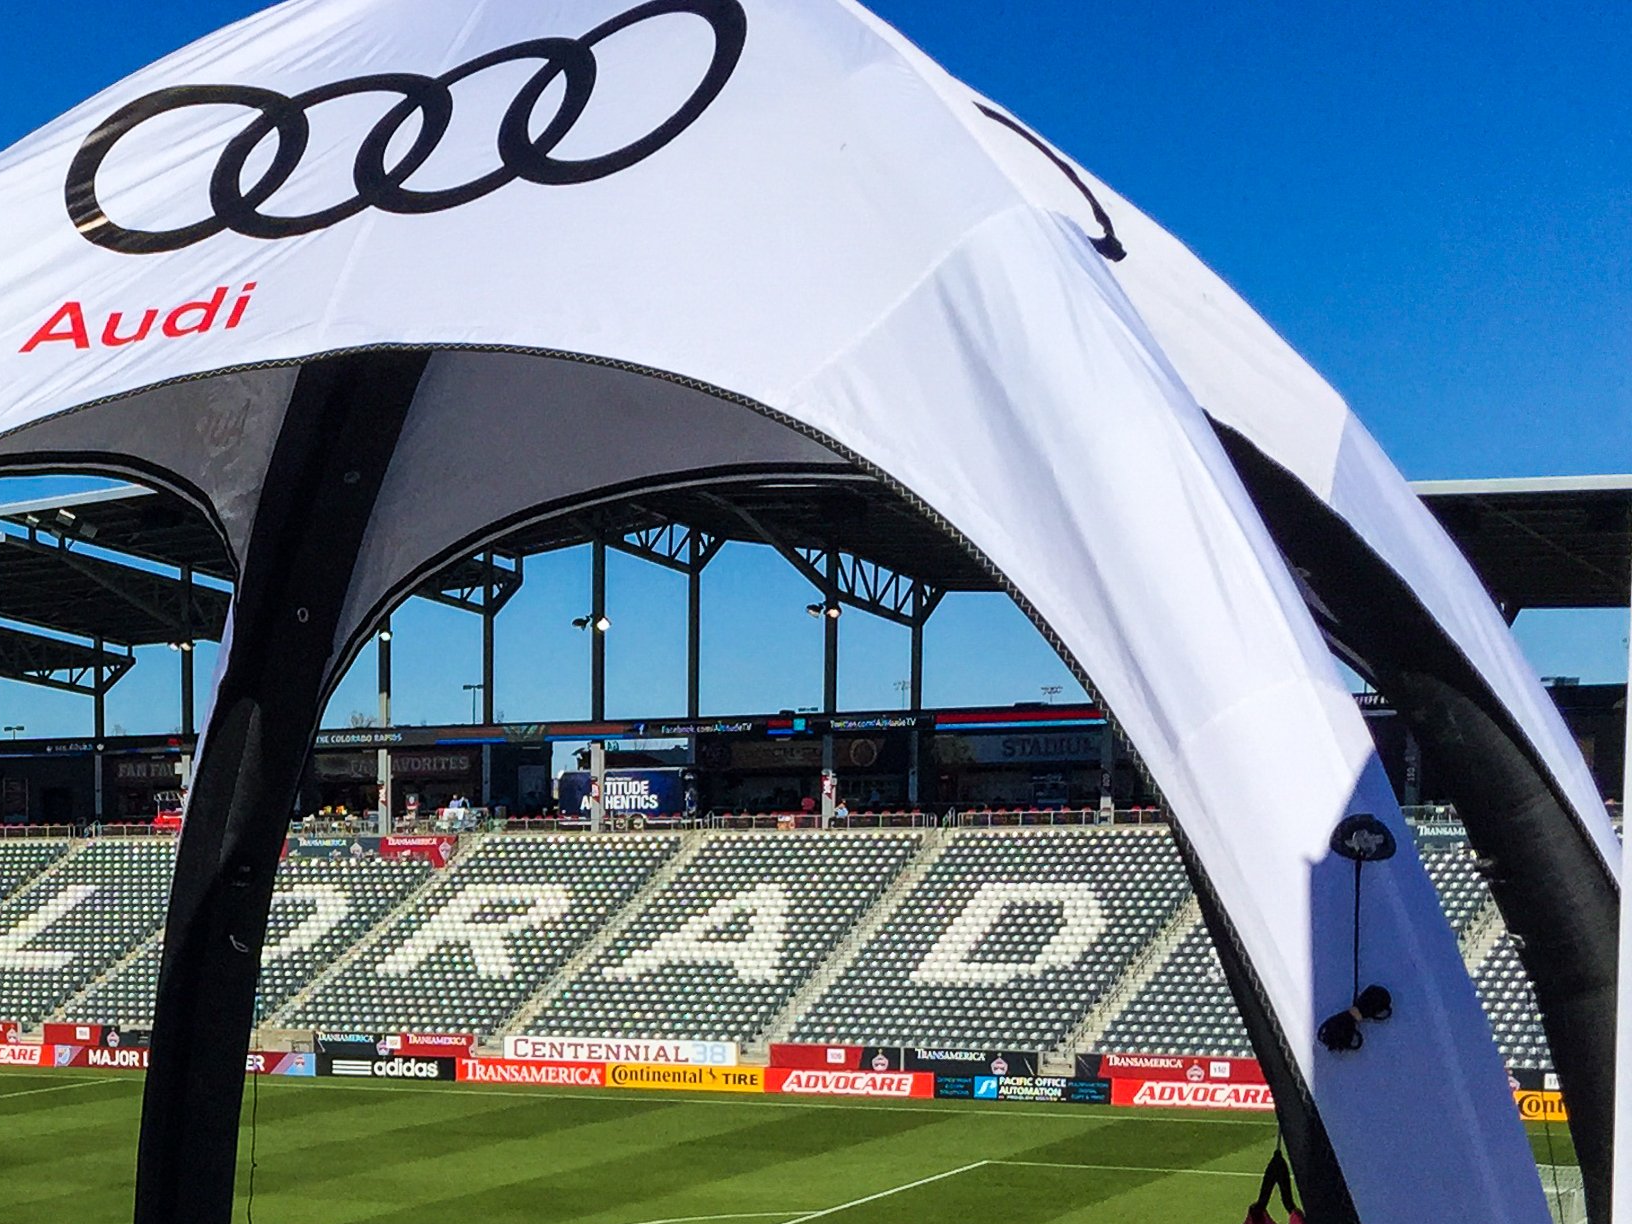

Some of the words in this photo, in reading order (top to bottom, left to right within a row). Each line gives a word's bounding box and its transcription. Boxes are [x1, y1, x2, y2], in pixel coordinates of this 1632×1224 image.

[17, 281, 258, 353] Audi
[391, 756, 469, 771] AVORITES
[316, 1031, 375, 1043] TRANSAMERICA
[406, 1033, 467, 1046] TRANSAMERICA
[88, 1048, 140, 1067] MAJOR
[513, 1037, 690, 1063] CENTENNIAL
[691, 1043, 727, 1065] 38
[915, 1048, 986, 1062] TRANSAMERICA
[373, 1057, 437, 1078] adidas
[1105, 1054, 1184, 1069] TRANSAMERICA
[461, 1058, 598, 1085] TRANSAMERICA
[611, 1064, 703, 1085] Continental
[722, 1073, 759, 1086] TIRE
[784, 1070, 912, 1093] ADVOCARE
[998, 1076, 1033, 1087] PACIFIC
[1035, 1077, 1067, 1088] OFFICE
[998, 1086, 1062, 1097] AUTOMATION
